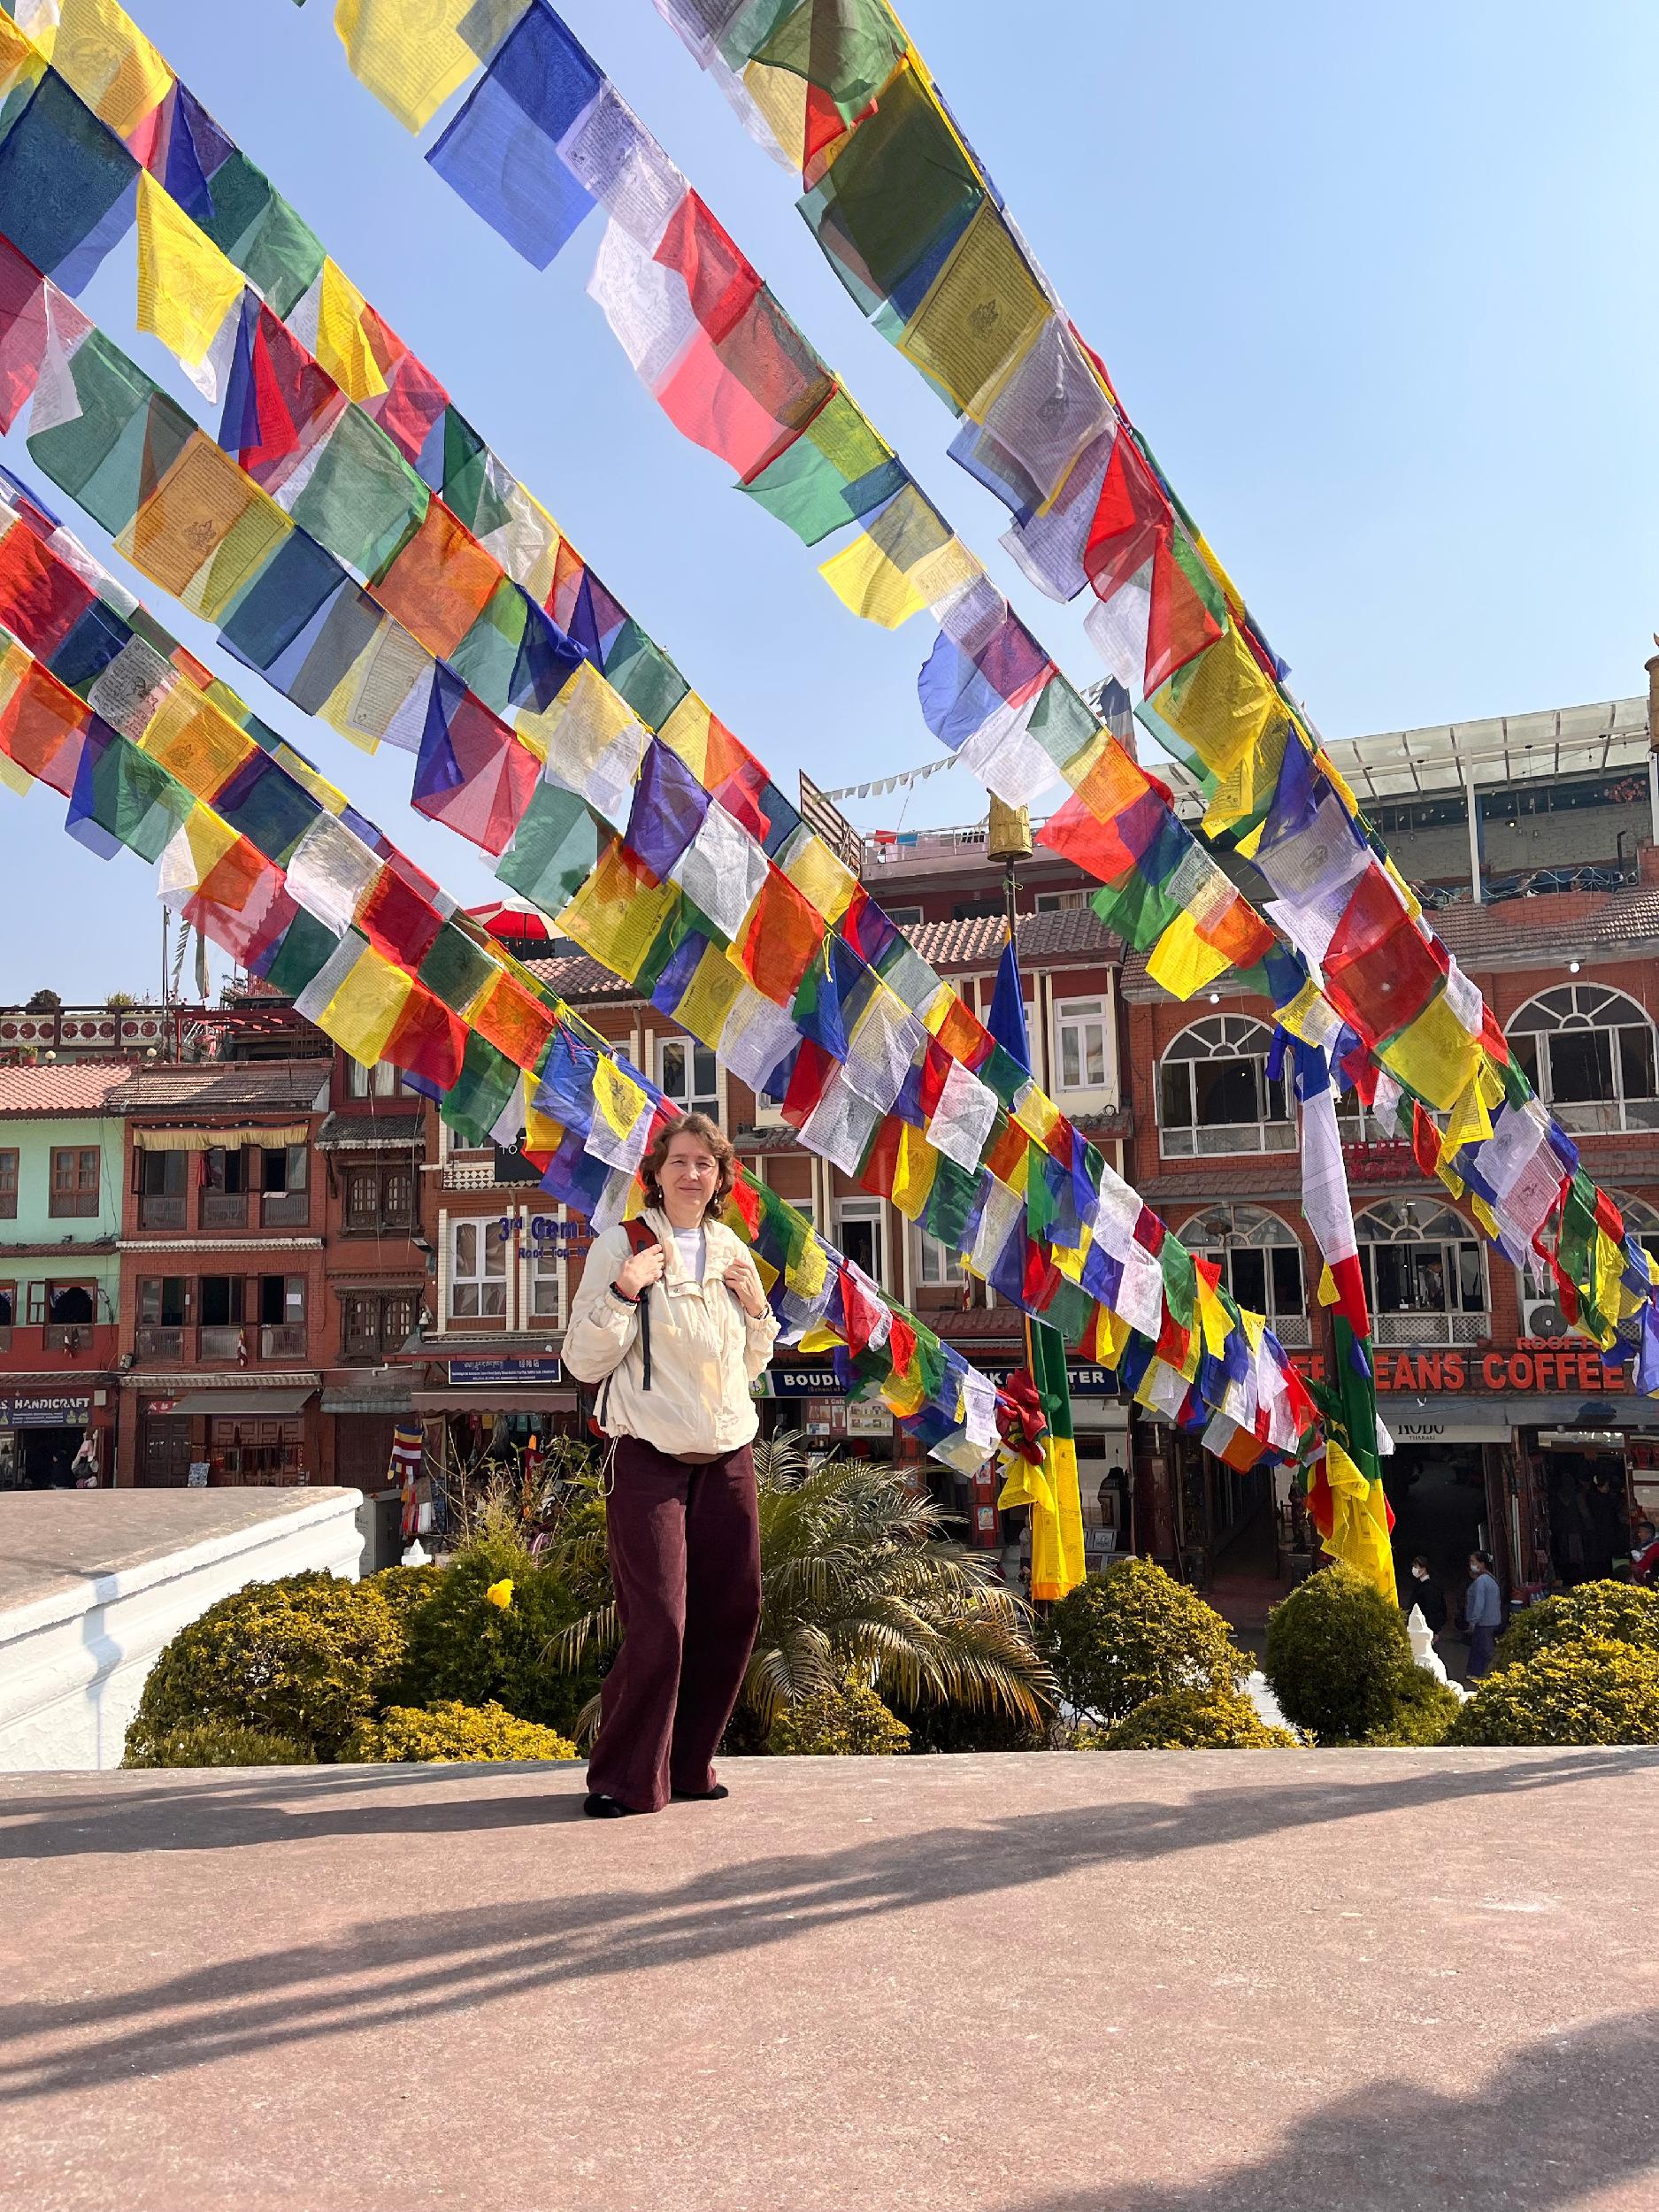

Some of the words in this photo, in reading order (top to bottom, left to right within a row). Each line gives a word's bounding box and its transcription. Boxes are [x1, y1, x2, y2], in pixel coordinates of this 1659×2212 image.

[498, 1217, 523, 1241] 3rd
[531, 1217, 580, 1240] Gem
[518, 1246, 544, 1259] Roof
[549, 1247, 570, 1260] Top
[1067, 1371, 1105, 1384] TER
[1373, 1353, 1465, 1390] EANS
[1482, 1353, 1625, 1390] COFFEE
[0, 1400, 9, 1410] S
[14, 1398, 89, 1409] HANDICRAFT
